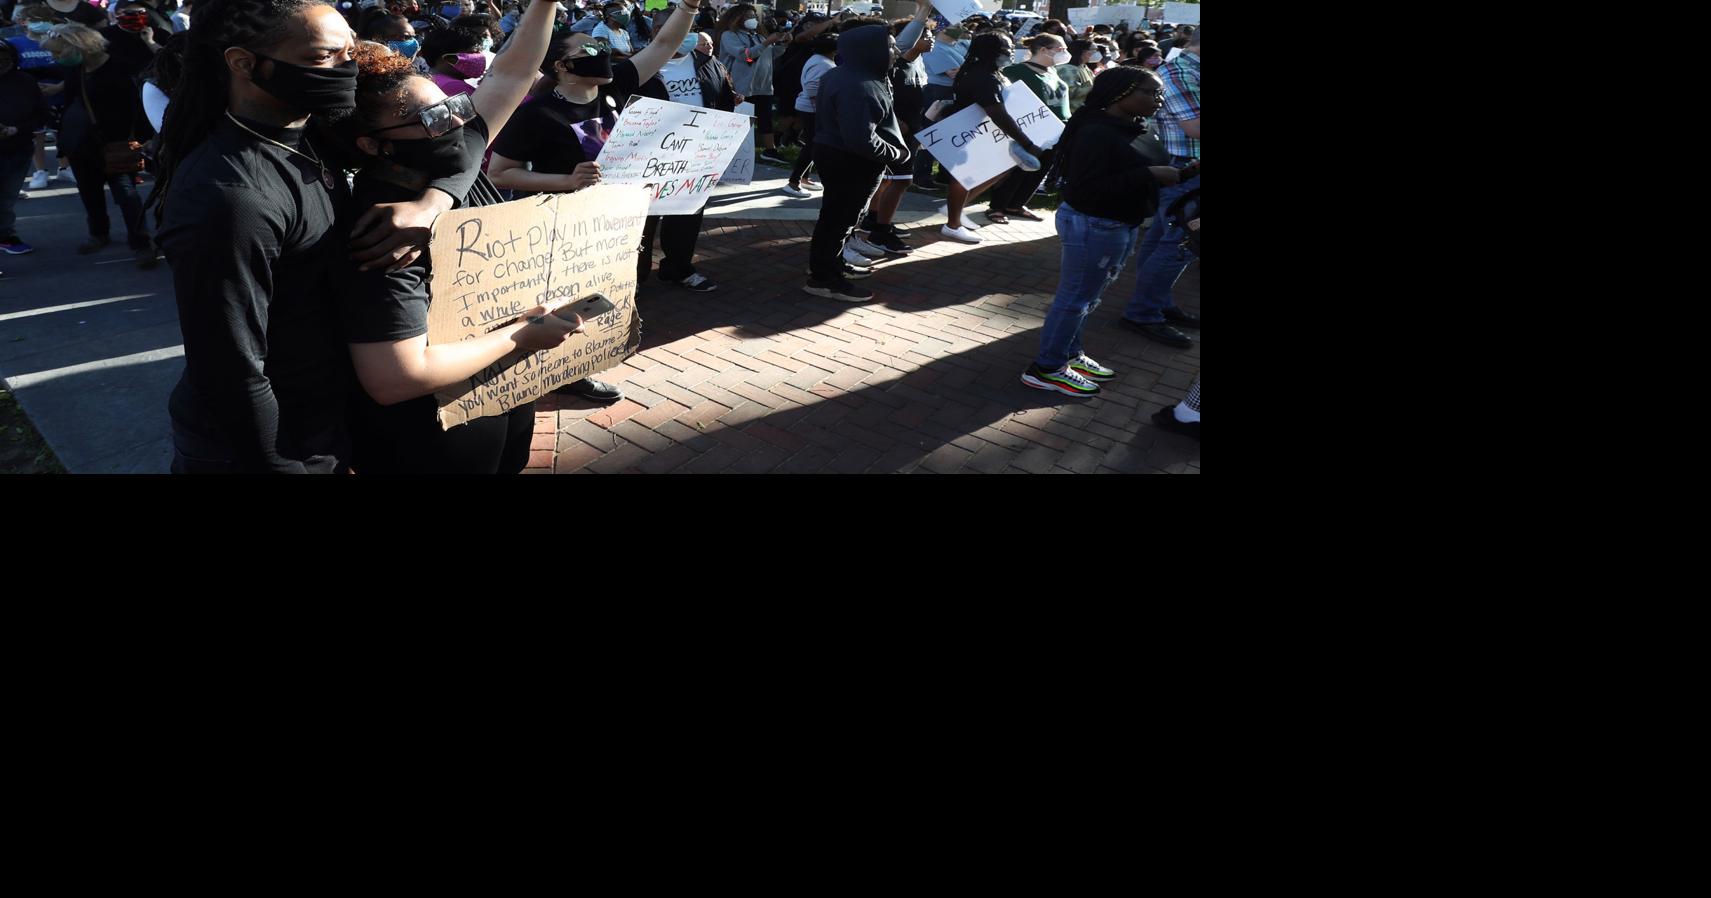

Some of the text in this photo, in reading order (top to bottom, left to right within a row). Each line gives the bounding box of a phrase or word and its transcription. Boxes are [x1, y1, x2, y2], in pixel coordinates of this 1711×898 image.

[683, 109, 708, 128] I
[923, 128, 943, 147] I
[951, 120, 990, 148] CANT
[642, 157, 689, 178] BREATH
[456, 218, 521, 268] Riot
[573, 220, 588, 238] in
[452, 270, 484, 287] for
[560, 240, 594, 262] But
[596, 235, 629, 252] more
[562, 261, 597, 277] there
[602, 256, 611, 266] is
[461, 316, 476, 328] a
[536, 282, 580, 306] person
[597, 311, 623, 328] Rage
[487, 377, 518, 400] want
[573, 348, 583, 360] to
[496, 384, 540, 411] Blame
